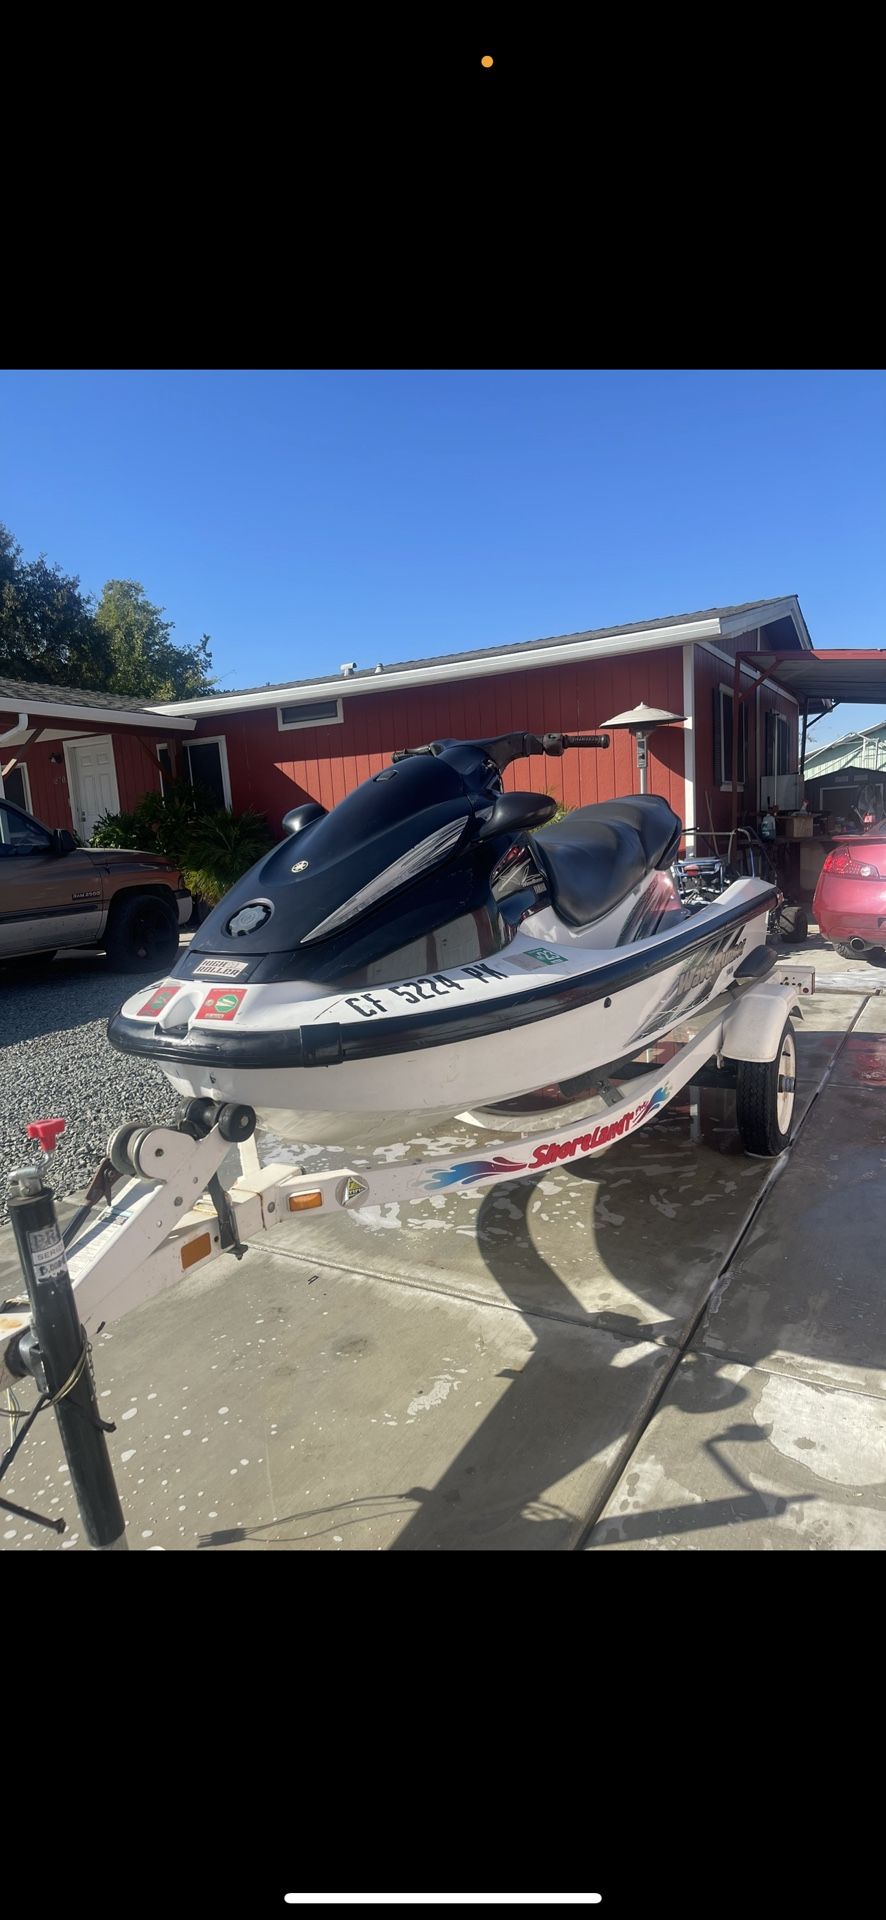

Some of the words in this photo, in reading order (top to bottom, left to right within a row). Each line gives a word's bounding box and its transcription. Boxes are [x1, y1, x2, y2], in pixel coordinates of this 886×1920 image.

[201, 960, 228, 968] HIGH
[196, 966, 241, 976] ROLLER
[344, 993, 388, 1017] CF
[388, 974, 465, 1004] 5224
[461, 963, 509, 984] PK
